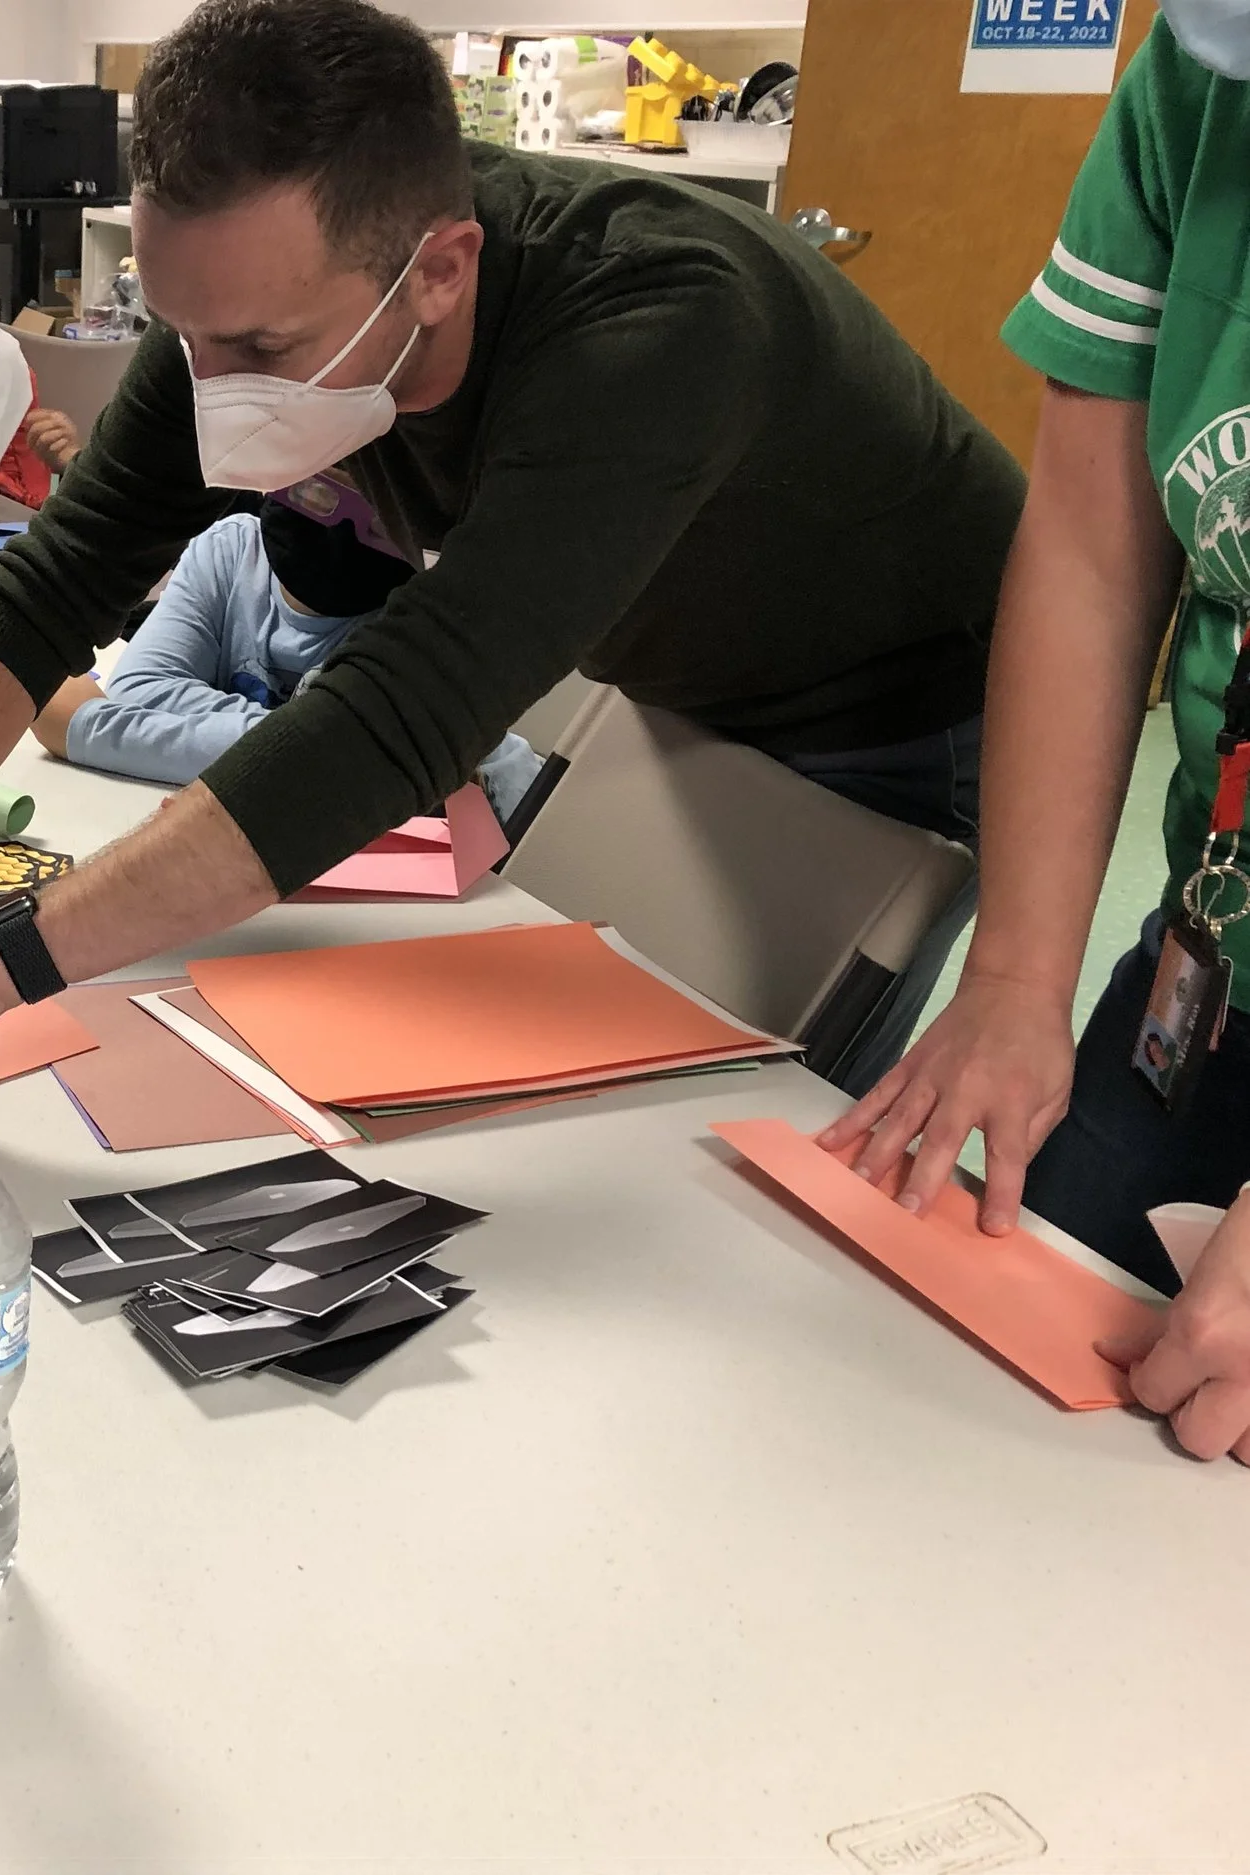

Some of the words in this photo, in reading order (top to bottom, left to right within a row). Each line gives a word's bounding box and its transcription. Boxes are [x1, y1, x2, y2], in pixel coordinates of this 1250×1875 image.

[986, 0, 1111, 21] WEEK
[982, 26, 1013, 40] OCT
[1015, 26, 1065, 41] 18-22,
[1069, 26, 1108, 40] 2021
